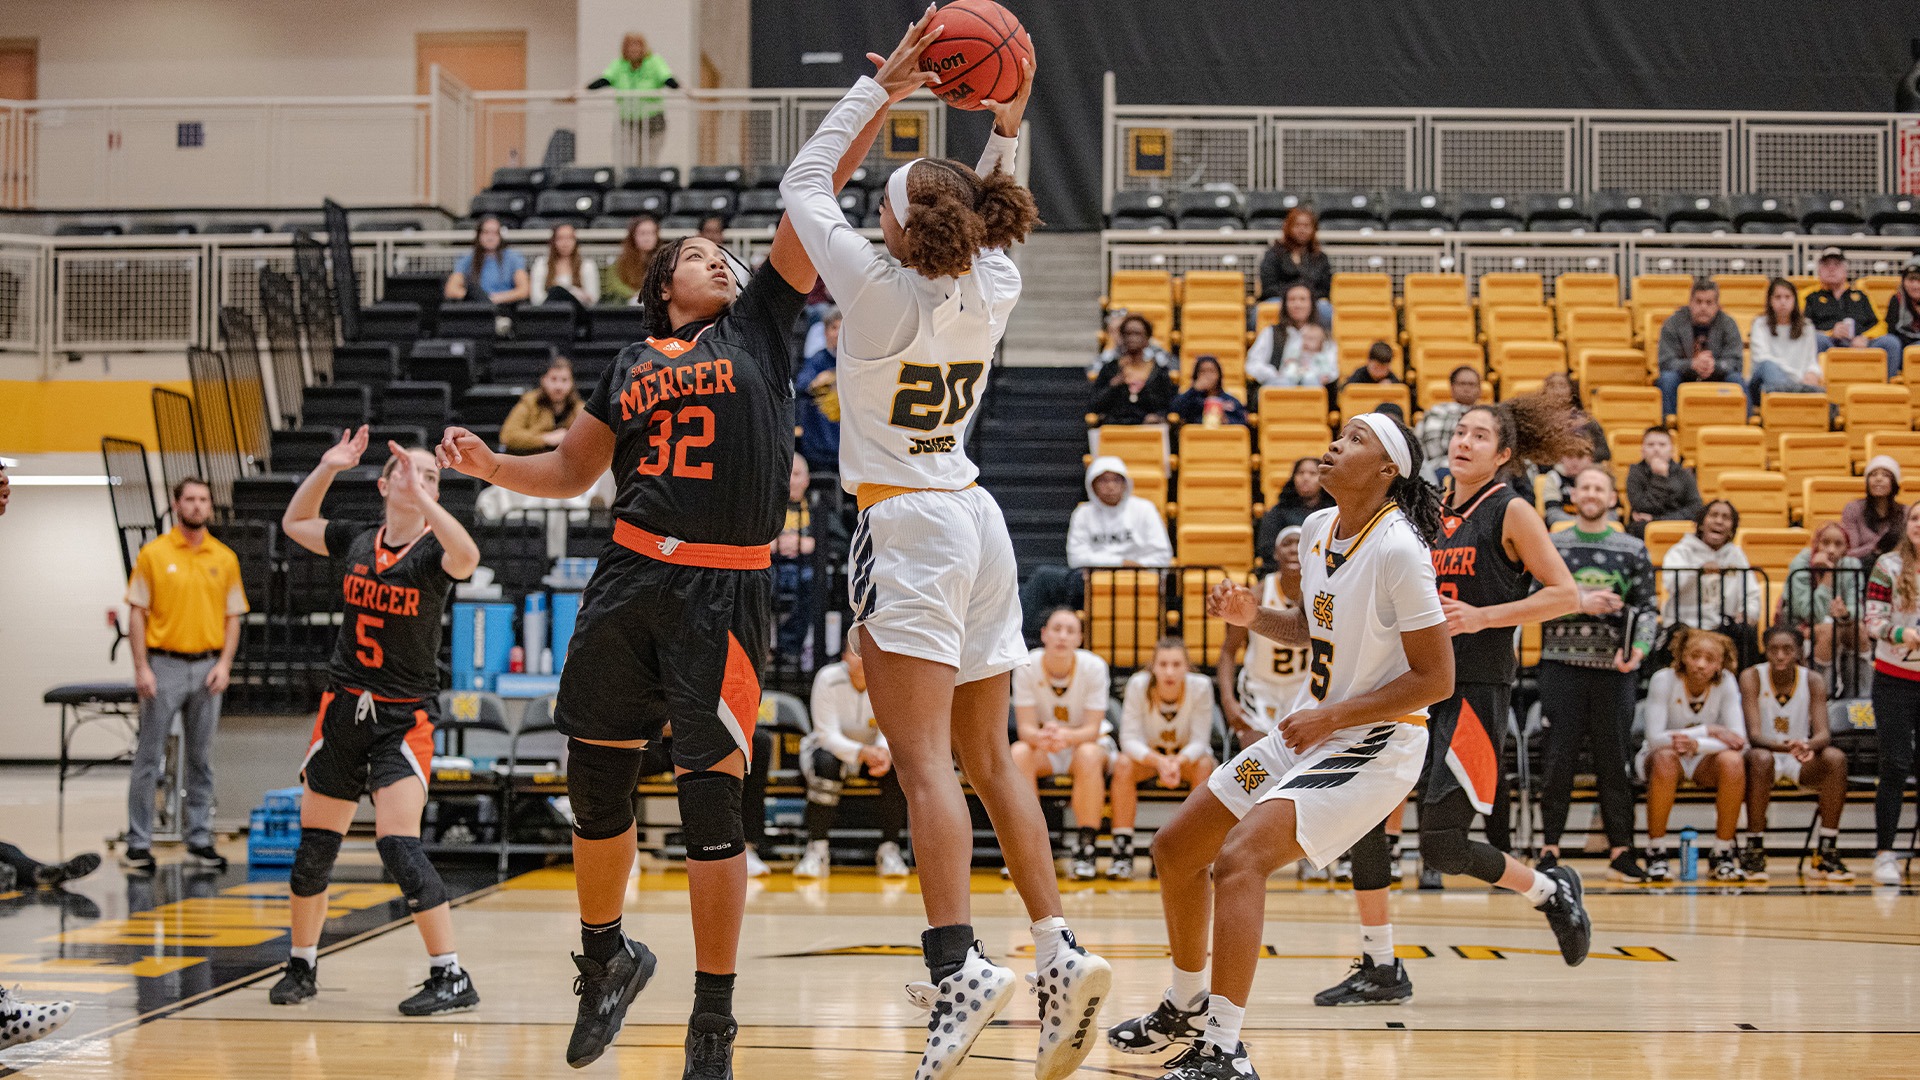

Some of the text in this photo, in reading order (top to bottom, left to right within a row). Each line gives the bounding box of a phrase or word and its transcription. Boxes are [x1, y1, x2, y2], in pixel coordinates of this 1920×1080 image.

[919, 52, 967, 74] ilson
[620, 358, 736, 421] MERCER
[888, 360, 984, 433] 20
[637, 405, 715, 480] 32
[1431, 546, 1477, 577] RCER
[343, 574, 421, 616] MERCER
[356, 613, 384, 668] 5
[1273, 646, 1309, 675] 21
[1310, 635, 1335, 703] 5
[702, 842, 732, 851] adidas
